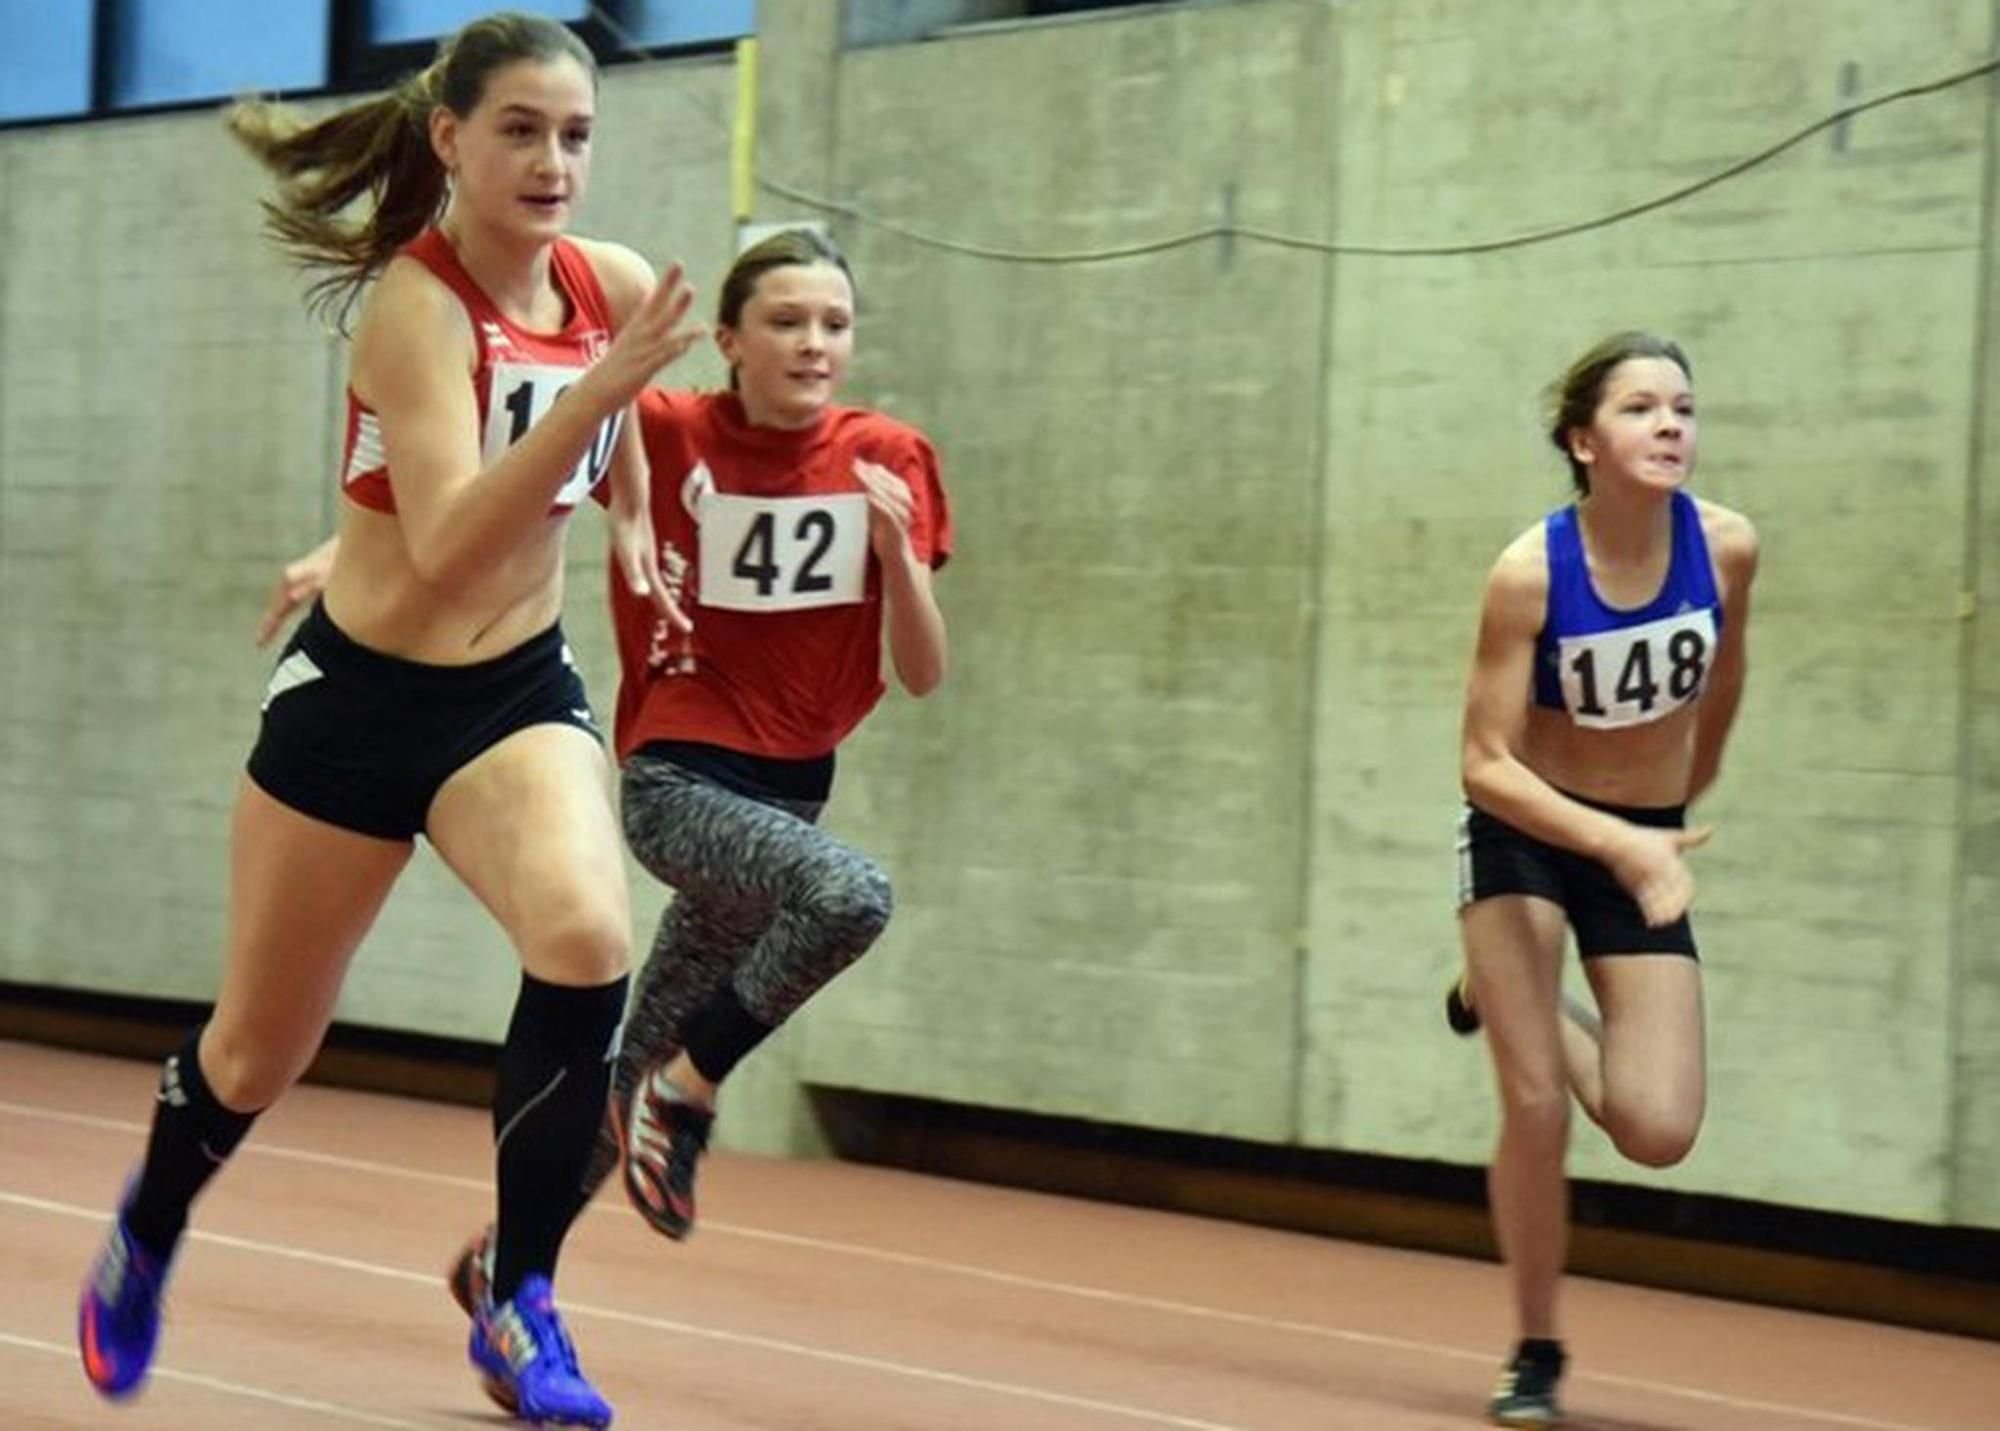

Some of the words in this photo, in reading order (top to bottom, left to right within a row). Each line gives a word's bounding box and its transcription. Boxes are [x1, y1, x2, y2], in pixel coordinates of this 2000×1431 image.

[505, 381, 617, 484] 10
[732, 509, 835, 596] 42
[1572, 629, 1705, 717] 148
